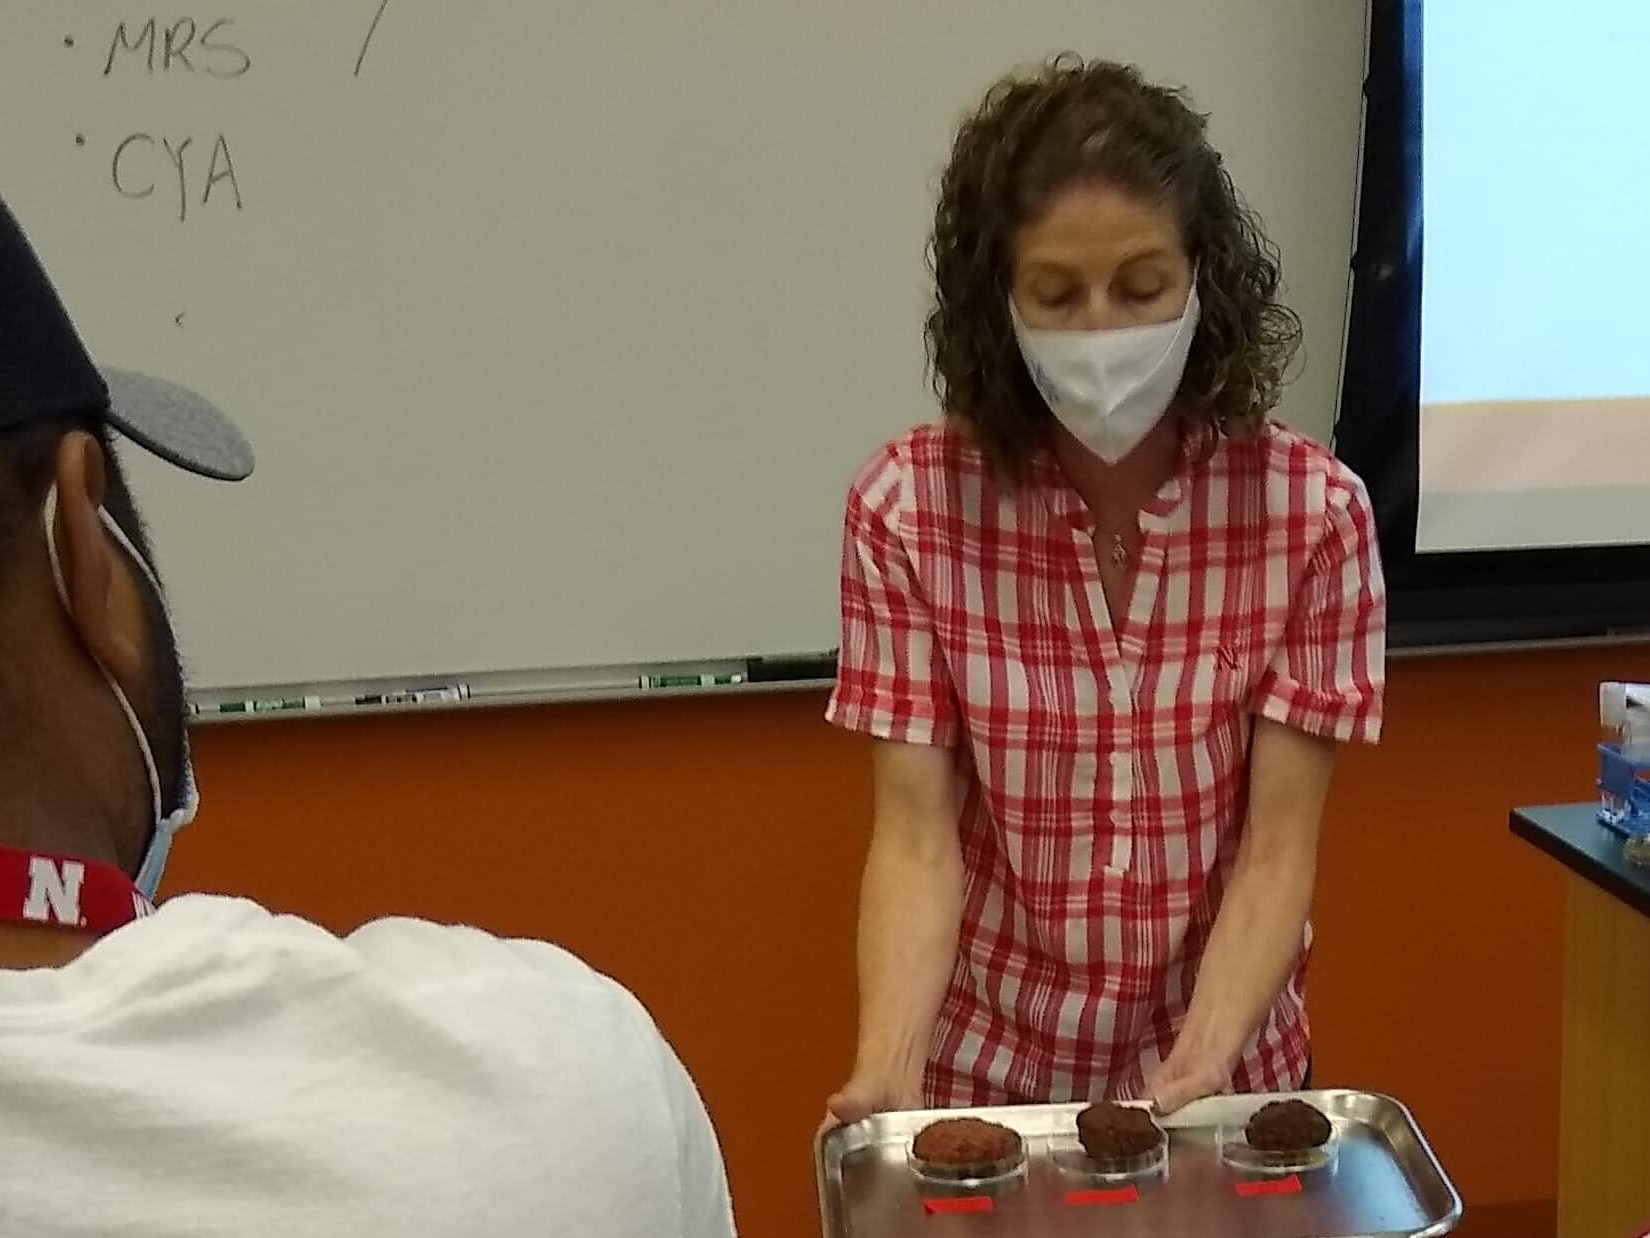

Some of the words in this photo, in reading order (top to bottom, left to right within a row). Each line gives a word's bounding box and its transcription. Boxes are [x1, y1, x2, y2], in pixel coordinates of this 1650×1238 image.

[104, 16, 251, 77] MRS
[112, 132, 242, 222] CYA
[23, 855, 85, 926] N
